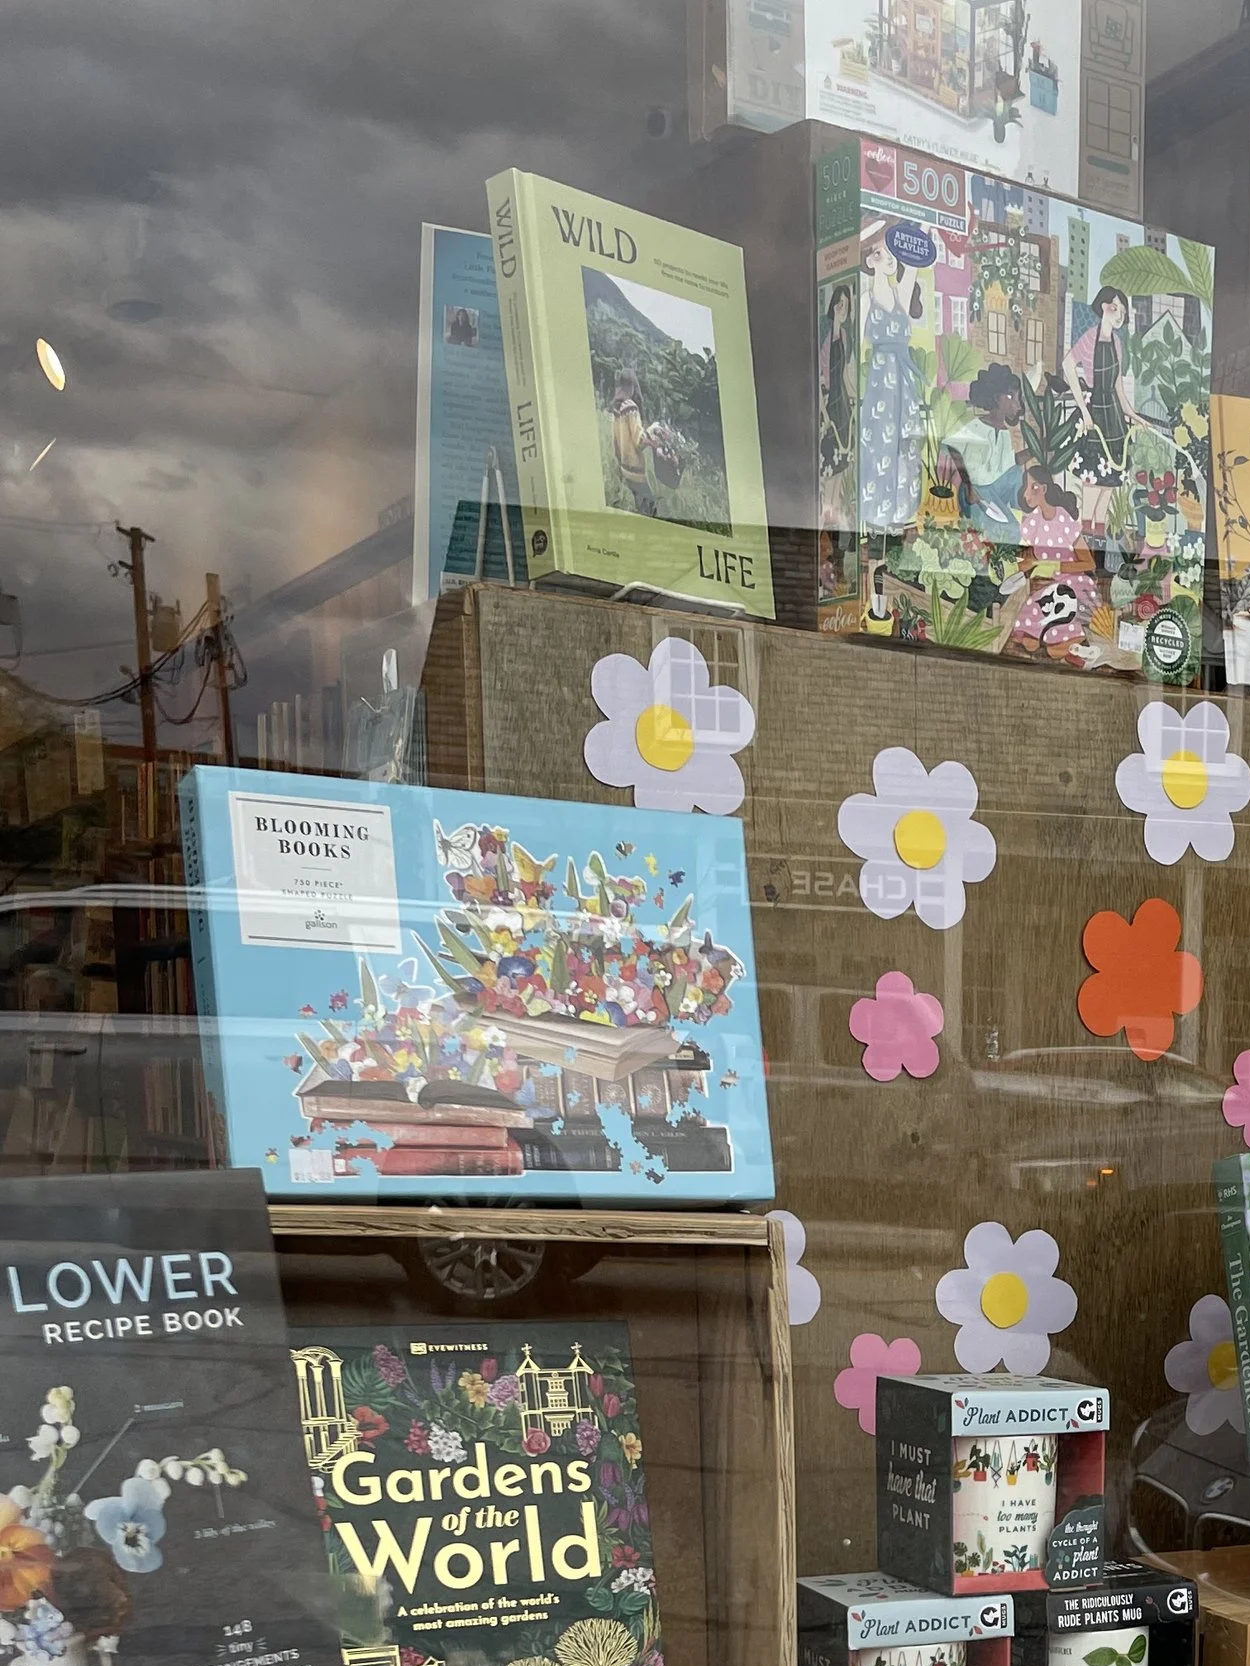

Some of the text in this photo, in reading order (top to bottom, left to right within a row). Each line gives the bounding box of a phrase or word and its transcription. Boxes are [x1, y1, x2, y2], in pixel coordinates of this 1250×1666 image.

[903, 160, 959, 207] 500
[551, 205, 637, 264] WILD
[939, 215, 965, 231] PUZZLE
[697, 544, 756, 590] LIFE
[1151, 635, 1185, 649] RECYCLED
[255, 816, 370, 841] BLOOMING
[278, 838, 351, 860] BOOKS
[8, 1250, 239, 1314] LOWER
[43, 1307, 244, 1345] RECIPE BOOK
[428, 1343, 489, 1352] EYEWITNESS
[963, 1407, 1069, 1427] Plant ADDICT
[331, 1442, 592, 1505] Gardens
[441, 1504, 520, 1535] of the
[892, 1504, 930, 1531] PLANT
[999, 1525, 1037, 1534] PLANTS
[334, 1501, 602, 1595] World
[1053, 1567, 1099, 1582] ADDICT
[397, 1593, 560, 1617] A celebration of the world's
[1064, 1593, 1134, 1611] THE RIDICULOUSLY
[412, 1610, 549, 1632] most amazing gardens
[1057, 1607, 1143, 1628] RUDE PLANTS MUG
